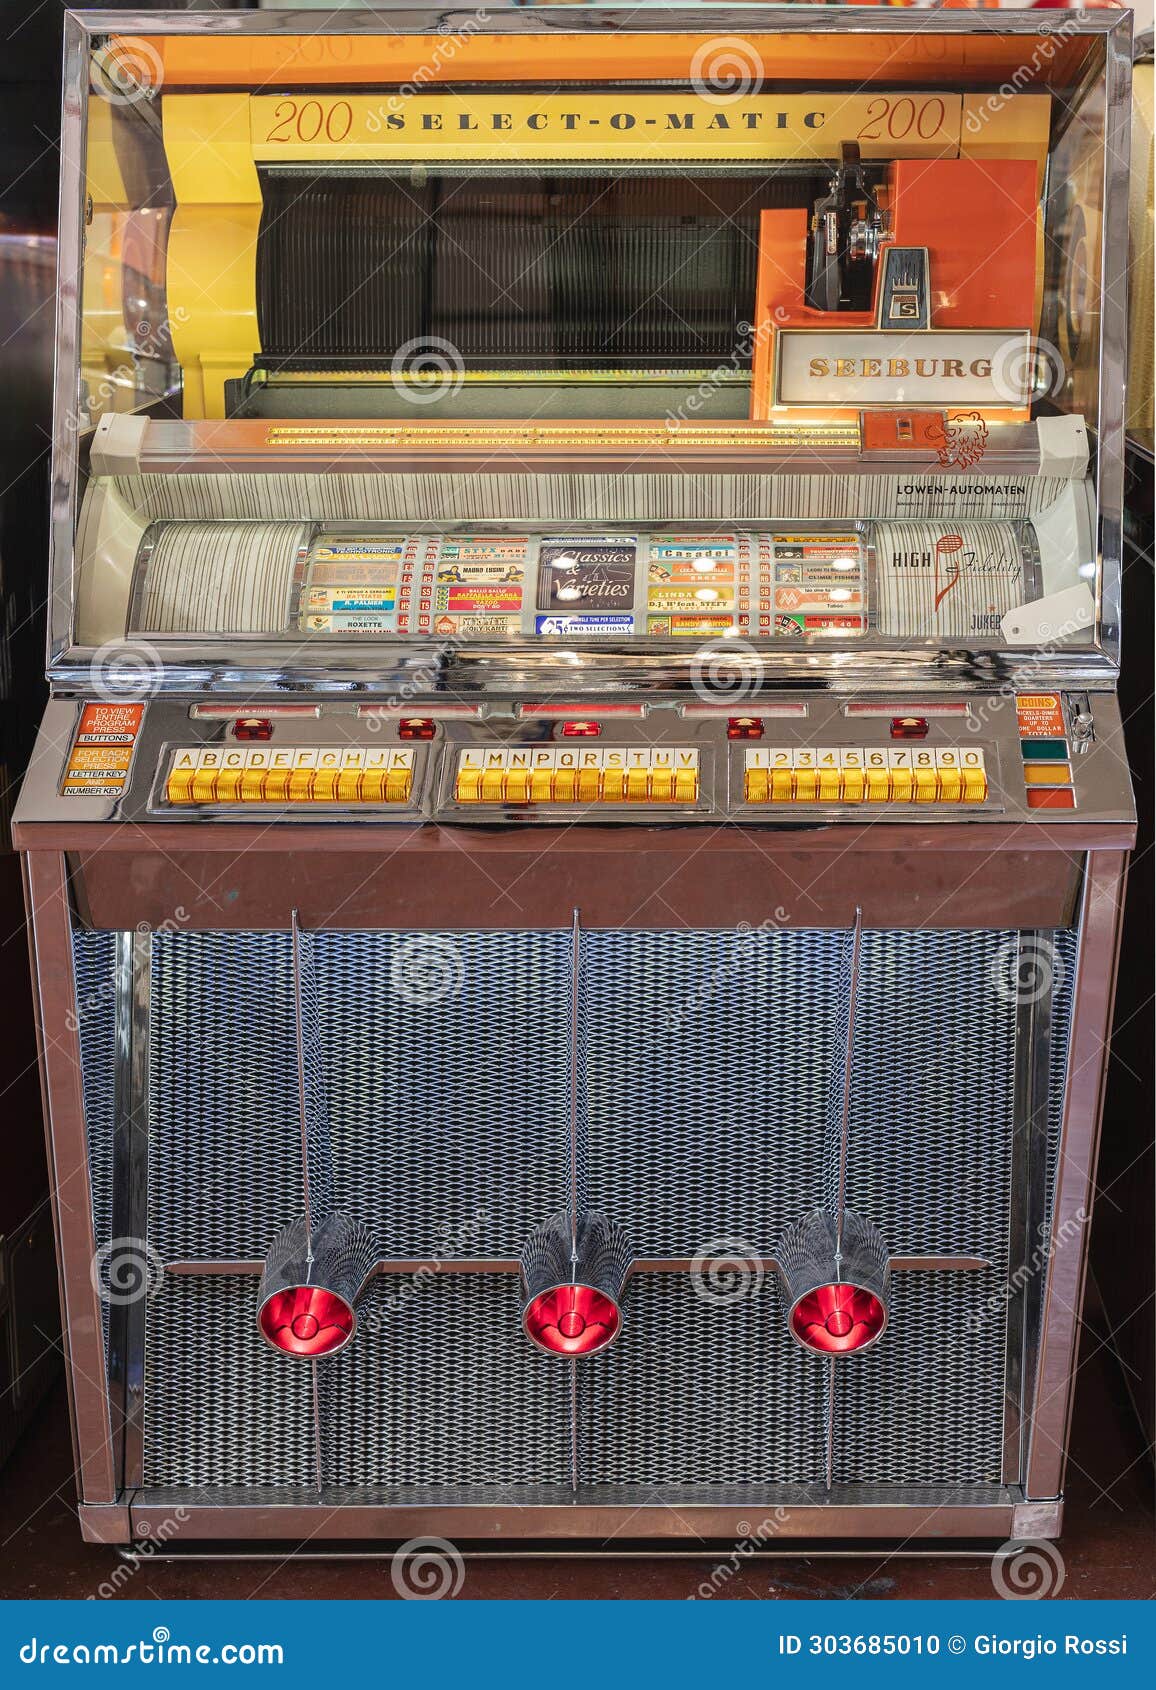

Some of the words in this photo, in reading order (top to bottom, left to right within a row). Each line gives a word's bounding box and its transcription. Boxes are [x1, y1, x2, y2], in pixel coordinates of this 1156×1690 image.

[266, 101, 352, 142] 200
[386, 111, 826, 131] SELECT-O-MATIC
[857, 98, 945, 140] 200
[809, 358, 993, 378] SEEBURG
[897, 485, 1025, 495] LÖWEN-AUTOMATEN
[892, 552, 931, 567] HIGH
[945, 552, 1022, 584] Fidelity
[422, 587, 431, 596] S5
[421, 601, 430, 610] T5
[420, 616, 429, 625] U5
[740, 616, 749, 625] J6
[970, 614, 1005, 630] JUKEB
[1022, 697, 1052, 708] COINS
[95, 707, 110, 715] TO
[110, 707, 135, 715] VIEW
[95, 713, 131, 721] ENTIRE
[78, 749, 101, 757] FOR
[101, 749, 129, 757] EACH
[179, 753, 193, 766] A
[203, 753, 217, 766] B
[227, 753, 240, 766] C
[250, 753, 265, 766] D
[274, 753, 289, 766] E
[297, 753, 313, 766] F
[322, 753, 337, 766] G
[345, 753, 360, 766] H
[369, 753, 384, 766] J
[393, 753, 408, 766] K
[465, 753, 478, 766] L
[489, 753, 503, 766] M
[512, 753, 526, 766] N
[536, 753, 550, 766] P
[560, 753, 574, 766] Q
[584, 753, 598, 766] R
[608, 753, 622, 766] S
[632, 753, 645, 766] T
[656, 753, 669, 766] U
[680, 753, 693, 766] V
[754, 752, 760, 765] 1
[775, 752, 788, 765] 2
[798, 752, 811, 765] 3
[822, 752, 836, 765] 4
[846, 752, 859, 765] 5
[870, 752, 884, 765] 6
[893, 752, 906, 765] 7
[917, 752, 931, 765] 8
[941, 752, 955, 765] 9
[965, 752, 979, 765] 0
